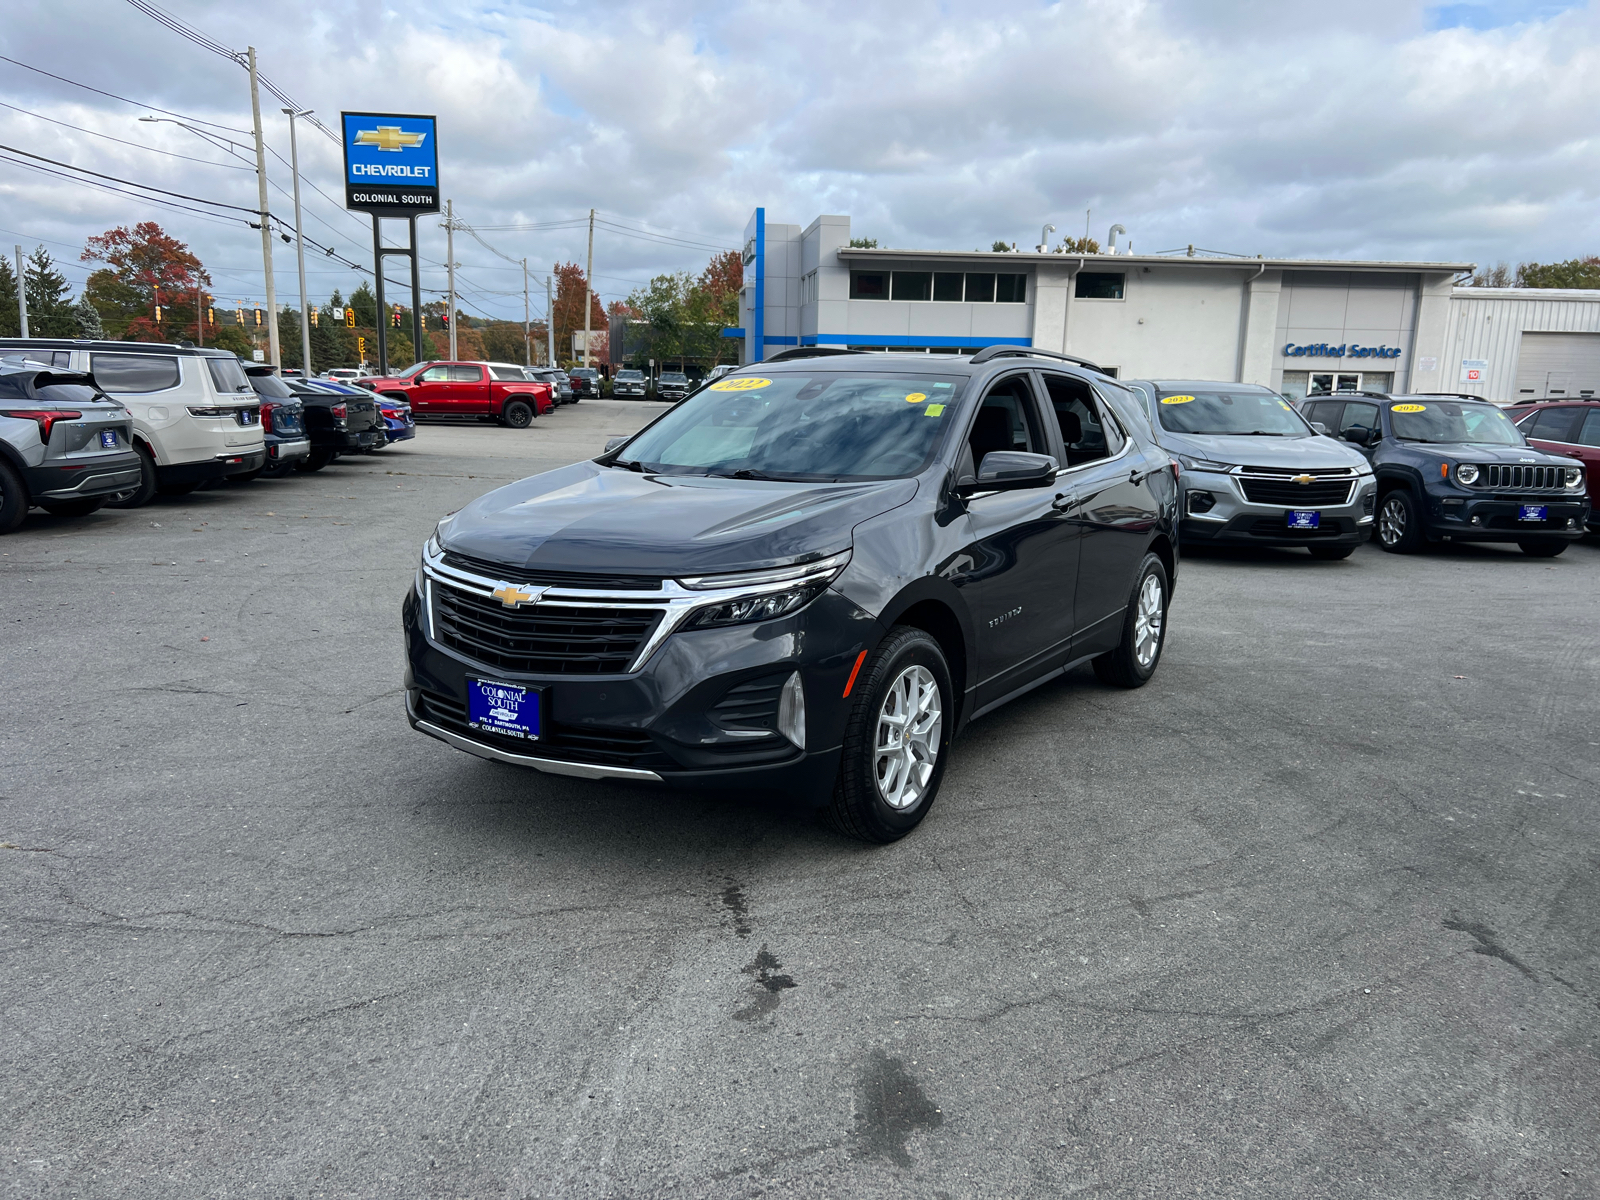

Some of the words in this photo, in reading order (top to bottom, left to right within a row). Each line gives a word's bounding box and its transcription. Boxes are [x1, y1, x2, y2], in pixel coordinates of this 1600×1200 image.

[352, 164, 431, 178] CHEVROLET
[353, 193, 399, 203] COLONIAL
[402, 195, 433, 204] SOUTH
[1285, 343, 1347, 357] Certified
[1350, 344, 1402, 358] Service
[1469, 371, 1478, 379] 10
[715, 380, 764, 389] 2022
[481, 686, 526, 703] COLONIAL
[487, 696, 519, 711] SOUTH
